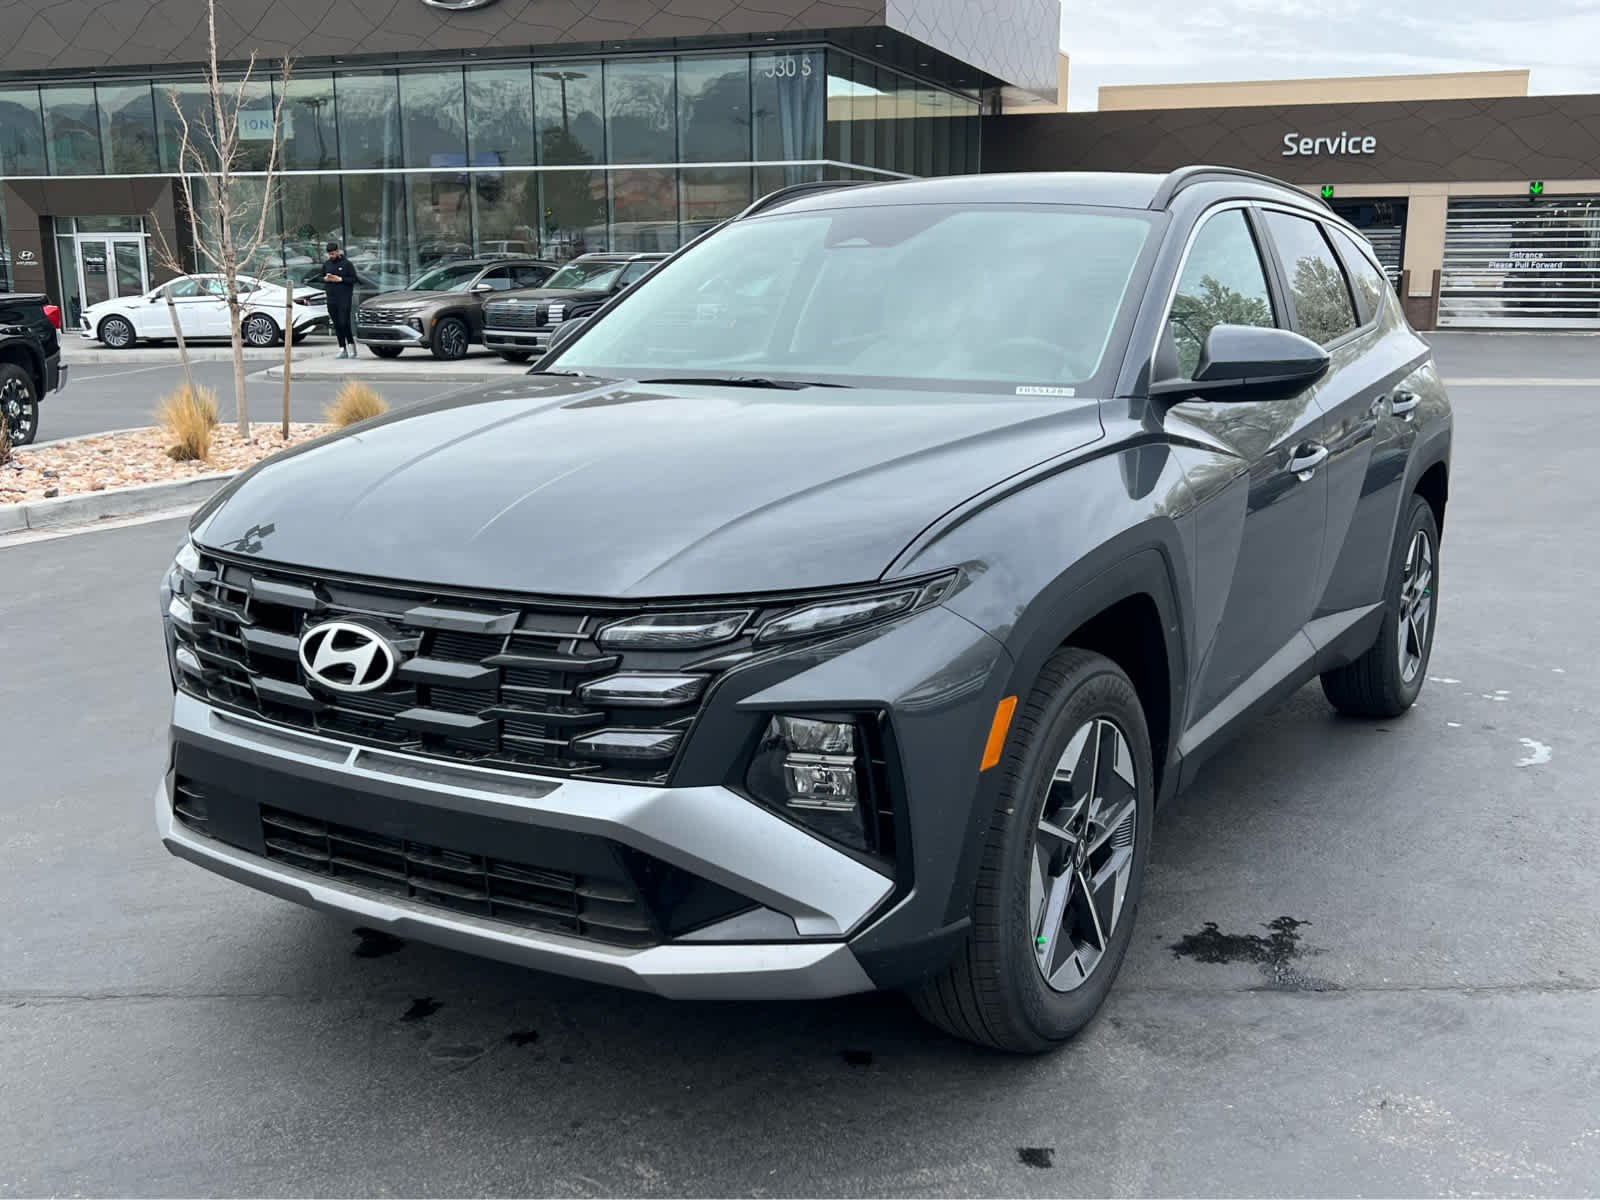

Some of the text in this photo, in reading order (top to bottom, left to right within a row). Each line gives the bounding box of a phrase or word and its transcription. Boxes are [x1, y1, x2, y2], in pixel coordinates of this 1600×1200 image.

[1282, 131, 1377, 156] Service
[1509, 251, 1544, 259] Entrance
[1488, 261, 1563, 269] Please Pull Forward
